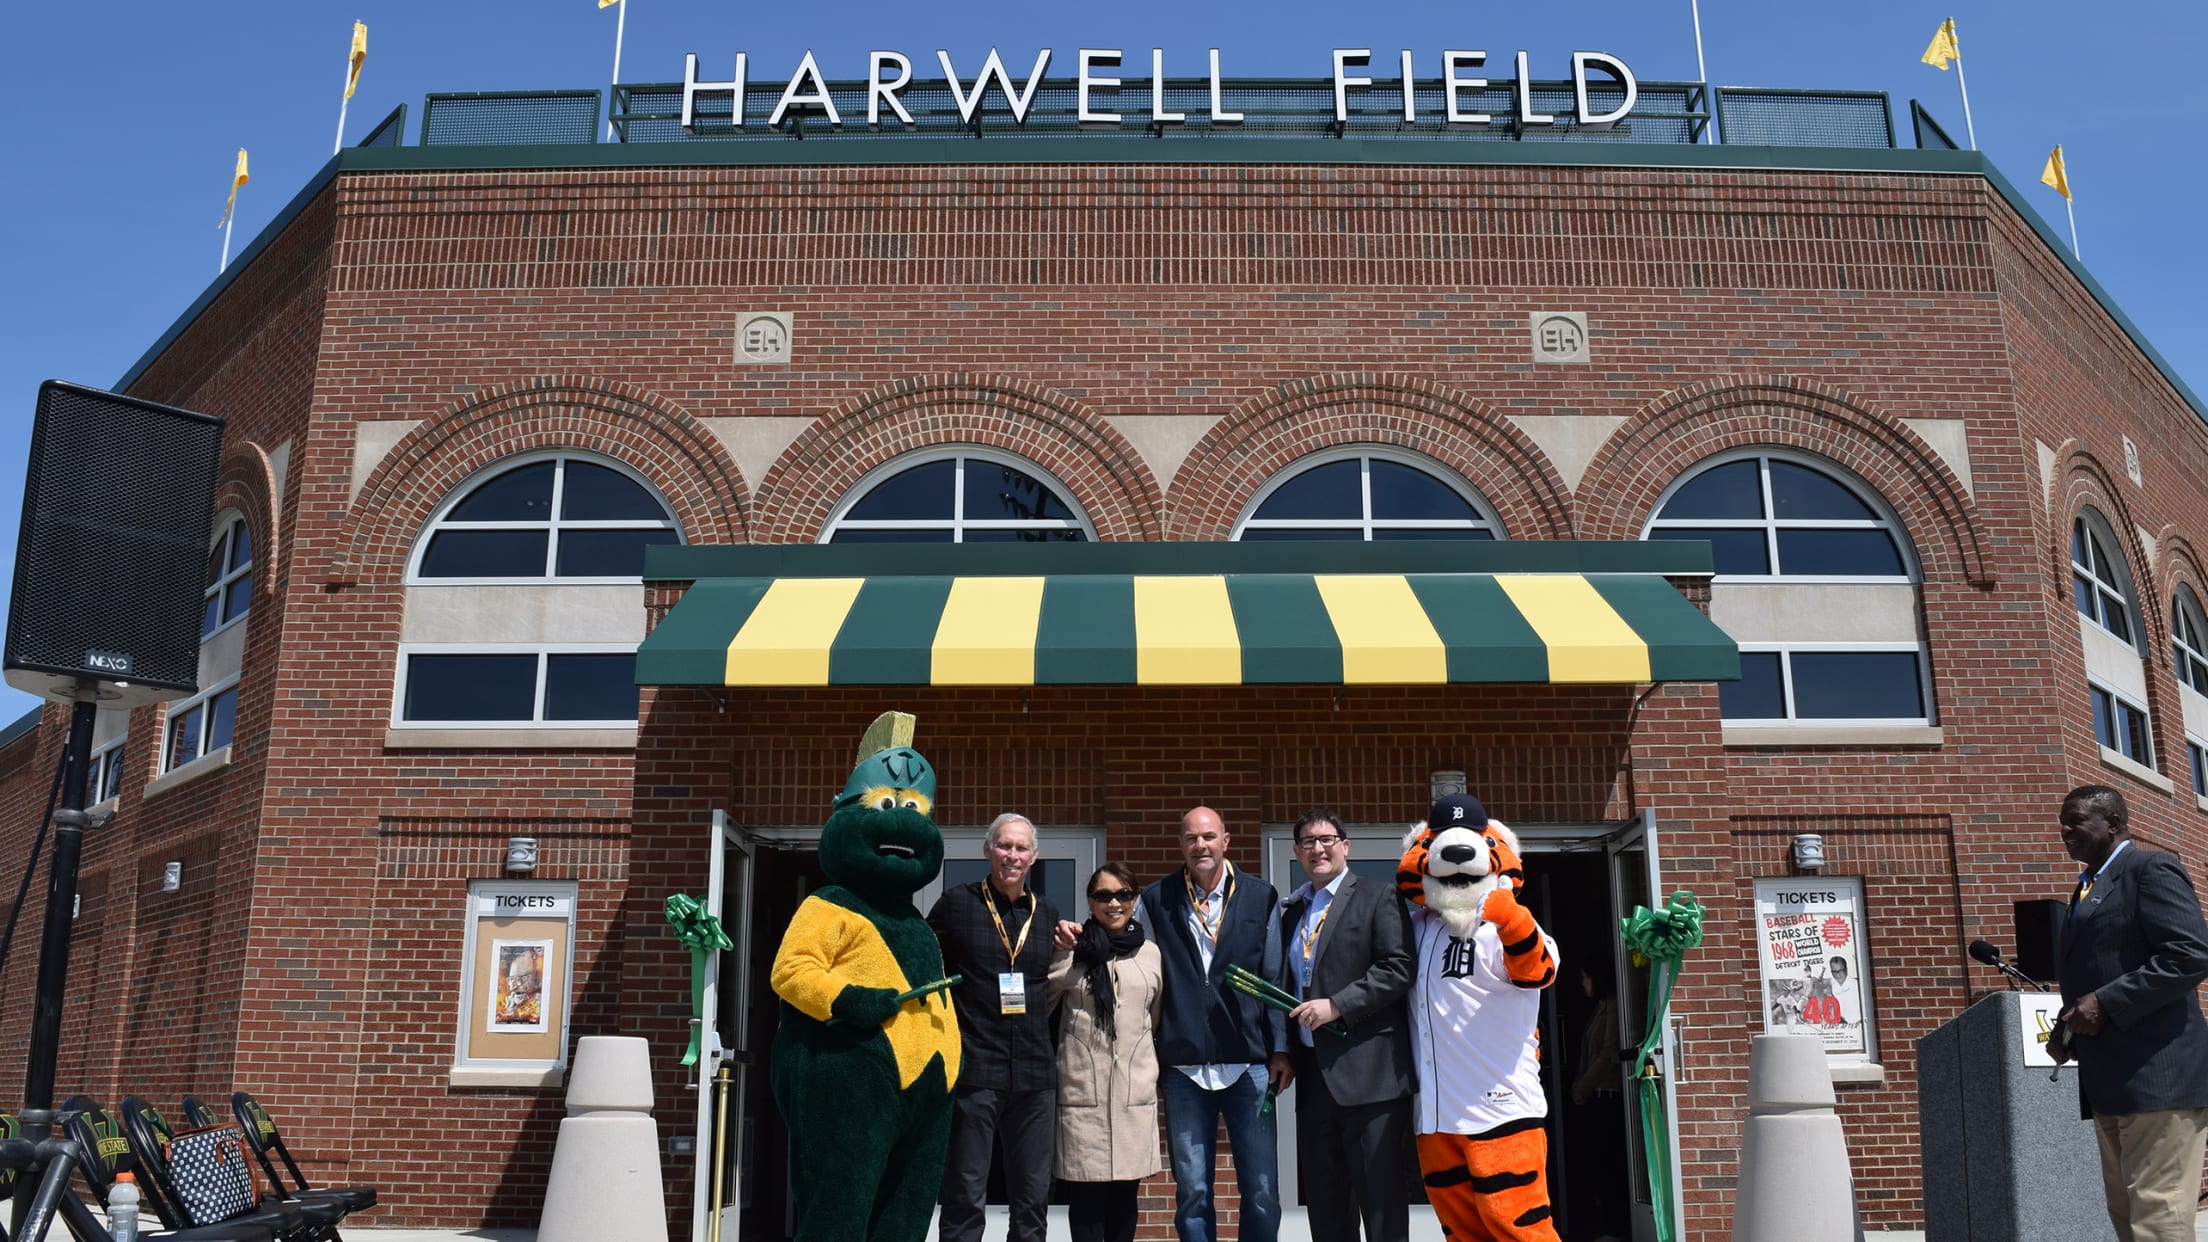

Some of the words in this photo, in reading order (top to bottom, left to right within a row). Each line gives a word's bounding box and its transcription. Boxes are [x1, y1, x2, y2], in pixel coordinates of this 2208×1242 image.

[680, 47, 1244, 130] HARWELL
[1333, 49, 1638, 127] FIELD
[90, 654, 128, 670] NEXO
[495, 895, 555, 908] TICKETS
[1776, 892, 1837, 904] TICKETS
[1766, 913, 1817, 928] BASEBALL
[1769, 928, 1801, 941] STARS
[1804, 925, 1819, 936] OF
[1771, 941, 1795, 960] 1968
[1795, 938, 1819, 948] WORLD
[1775, 960, 1800, 970] DETROIT
[1803, 957, 1825, 967] TIGERS
[1803, 995, 1841, 1024] 40
